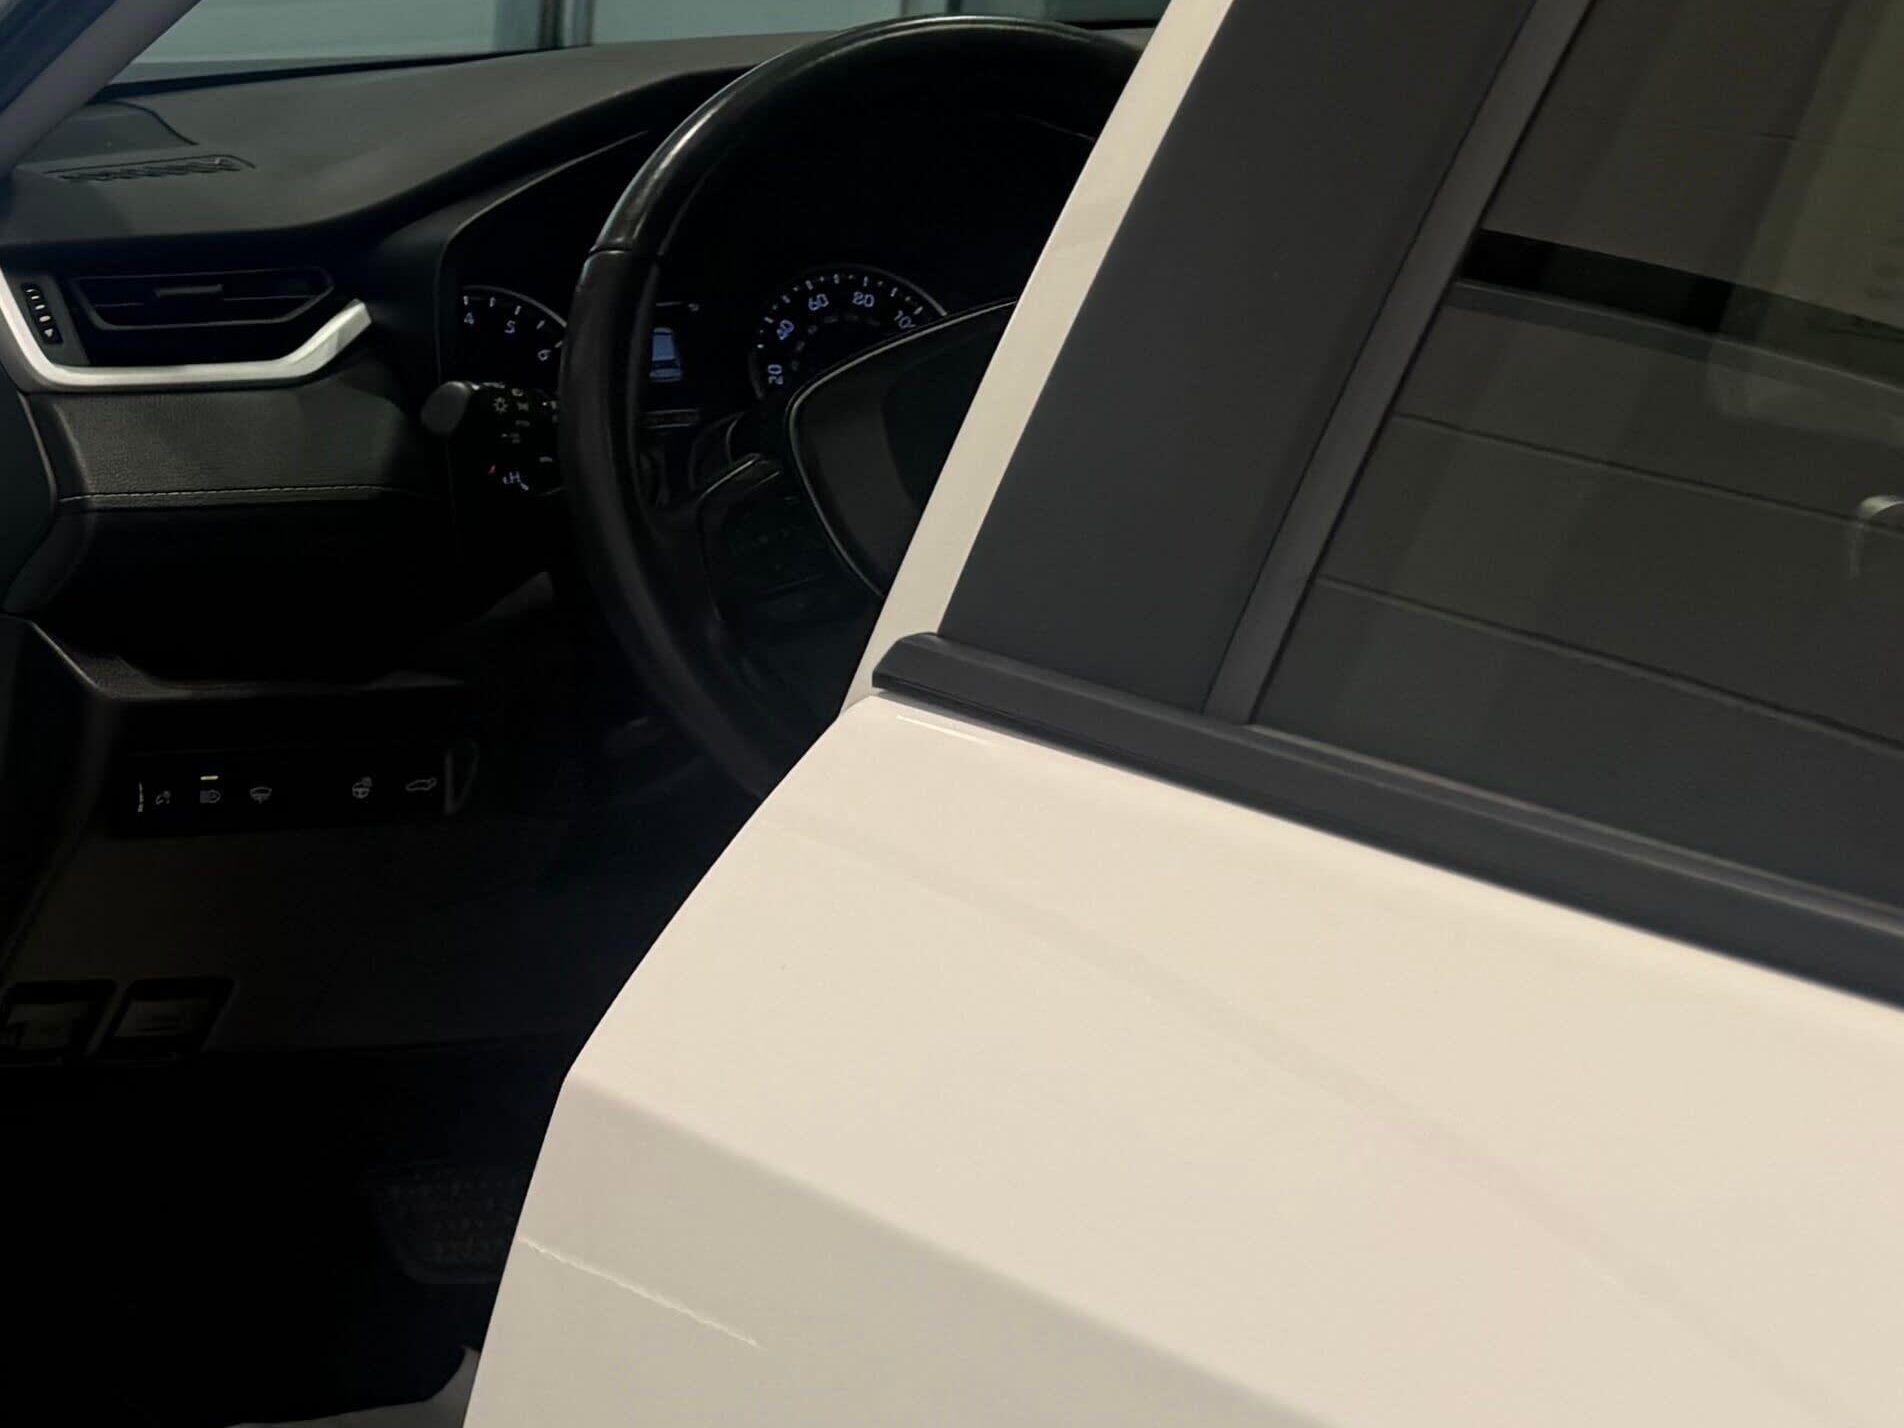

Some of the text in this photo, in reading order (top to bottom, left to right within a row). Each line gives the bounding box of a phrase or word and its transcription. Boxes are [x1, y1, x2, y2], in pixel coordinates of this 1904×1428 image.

[807, 292, 830, 312] 60
[851, 290, 876, 309] 80
[463, 312, 475, 325] 4
[504, 319, 516, 334] 5
[775, 319, 796, 341] 40
[537, 348, 552, 361] 6
[767, 363, 784, 386] 20
